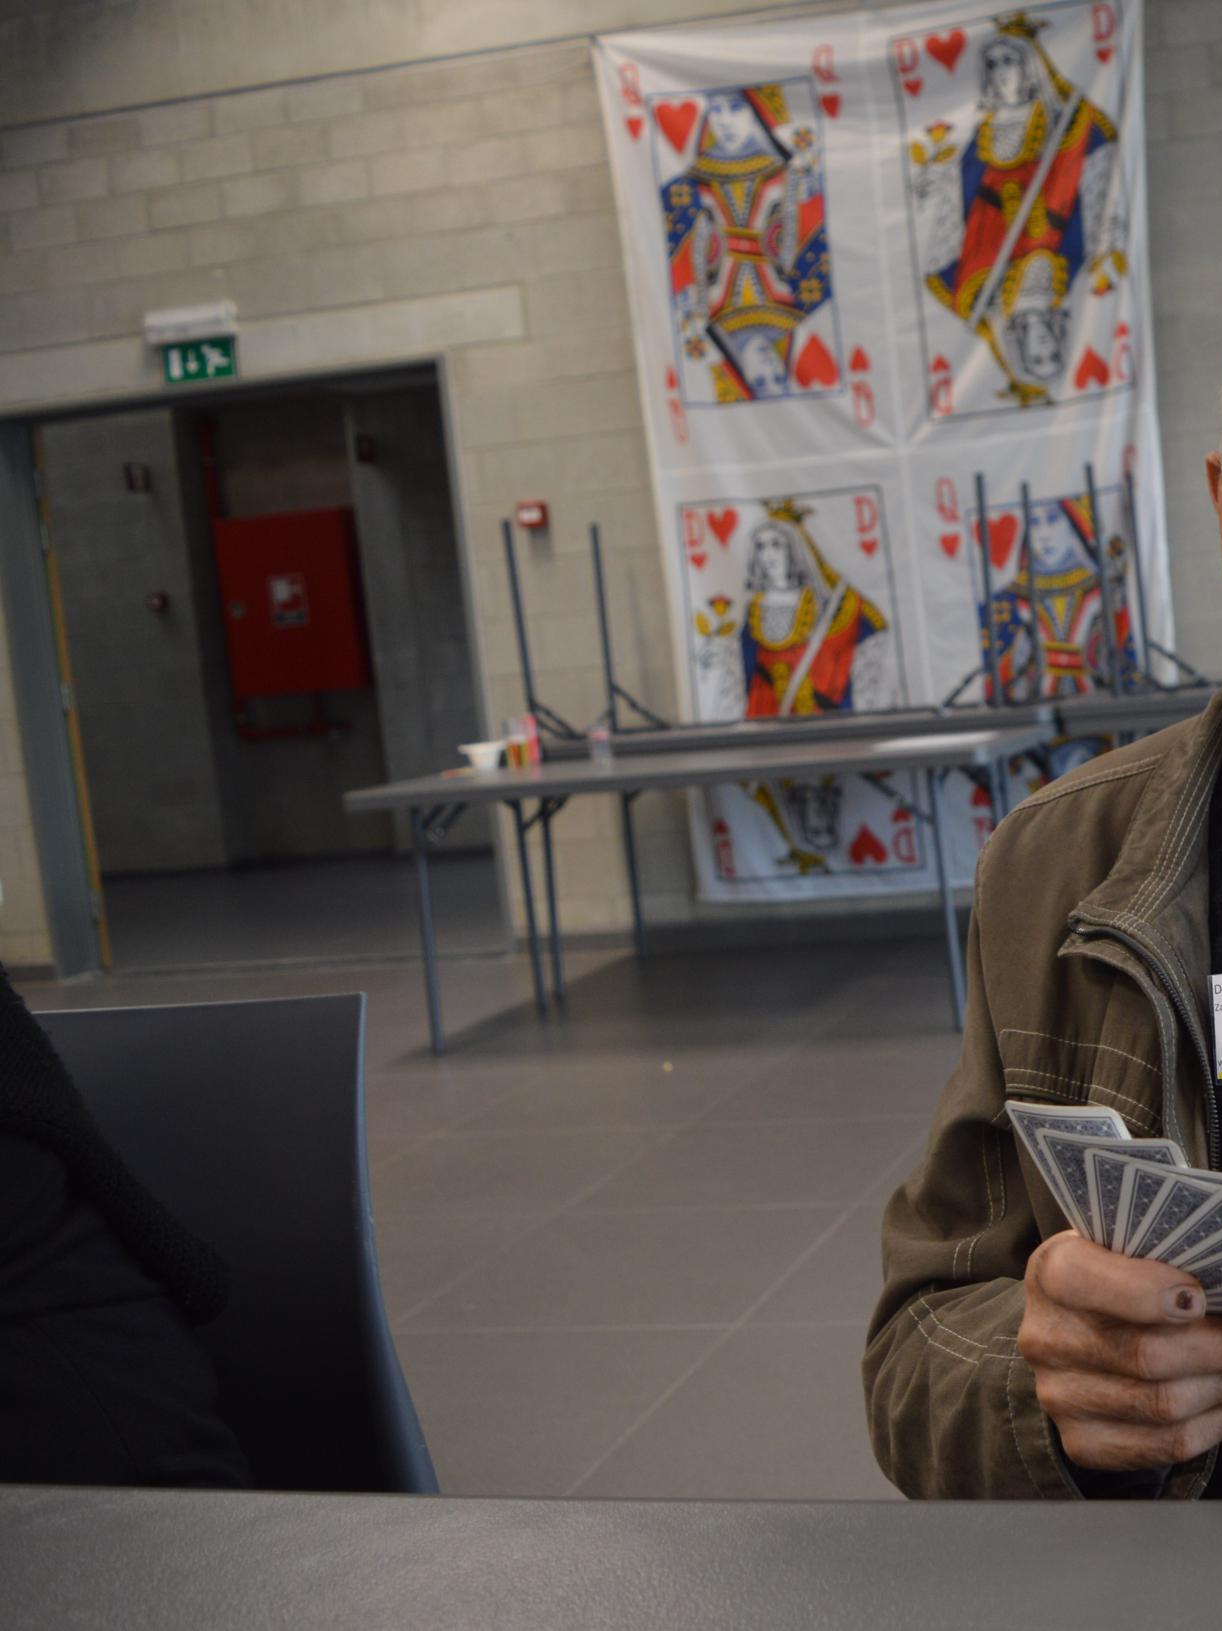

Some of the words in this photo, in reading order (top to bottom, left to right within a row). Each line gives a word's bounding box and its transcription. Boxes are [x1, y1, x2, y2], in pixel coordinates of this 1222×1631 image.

[1091, 3, 1115, 42] D
[895, 38, 919, 74] D
[855, 496, 878, 533] D
[935, 477, 960, 523] Q
